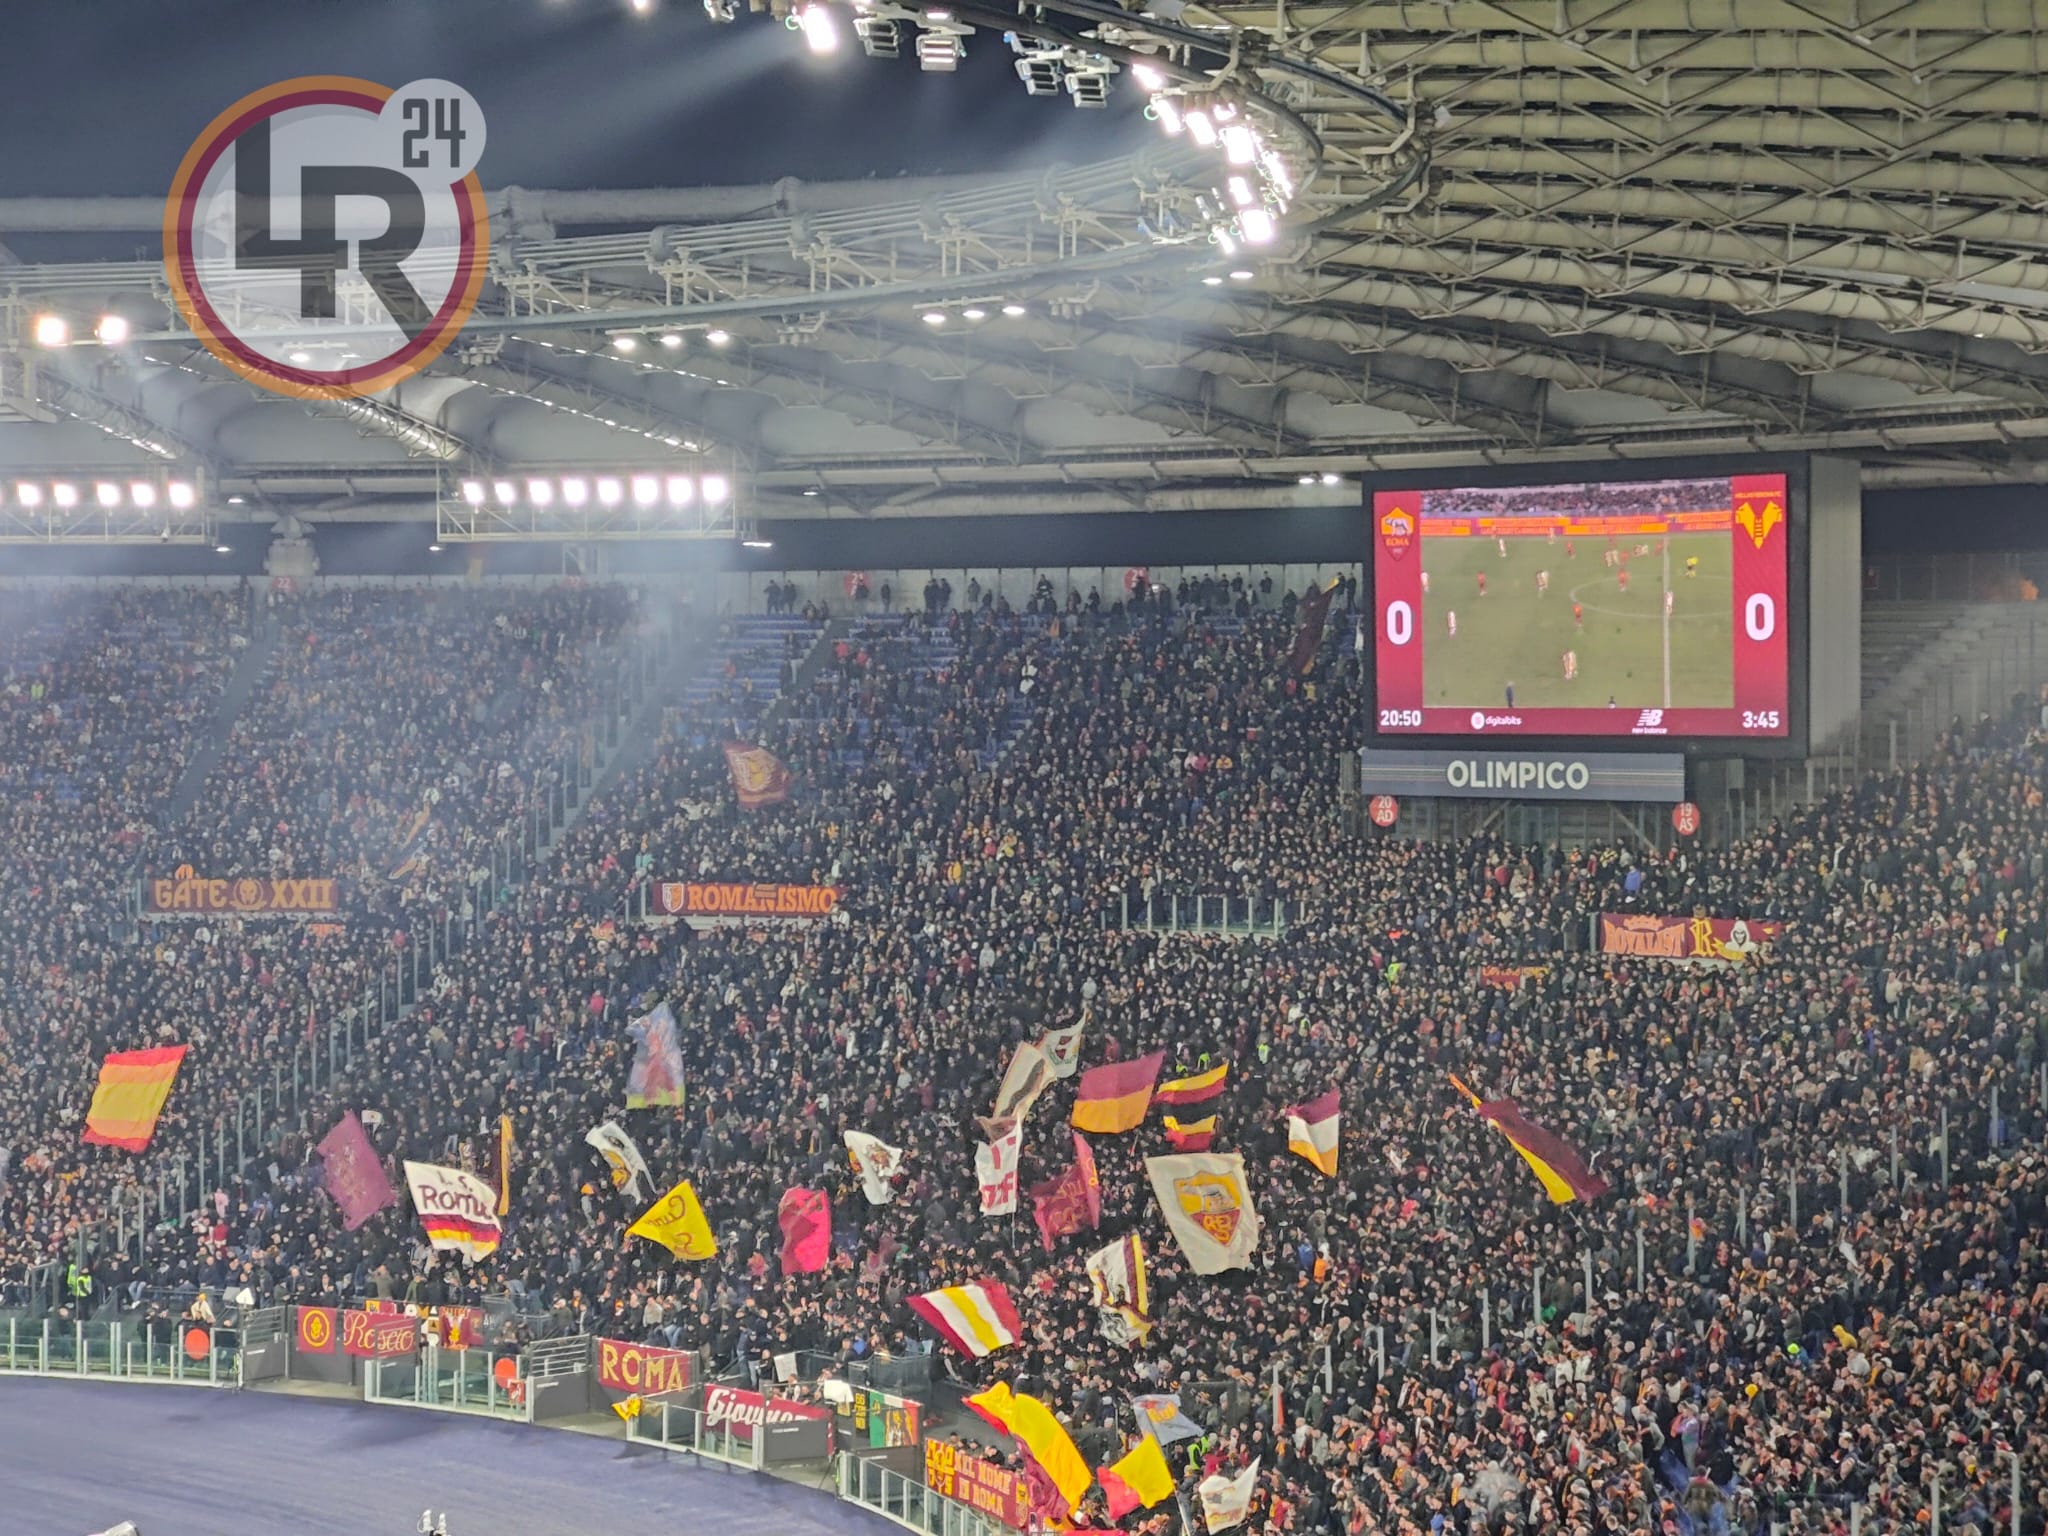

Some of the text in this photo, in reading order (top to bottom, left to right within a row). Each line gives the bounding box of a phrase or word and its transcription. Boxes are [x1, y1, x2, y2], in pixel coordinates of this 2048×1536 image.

[1386, 600, 1412, 646] 0
[1745, 592, 1775, 641] 0
[1380, 709, 1422, 727] 20:50
[1742, 710, 1780, 728] 3:45
[1447, 759, 1590, 790] OLIMPICO
[1378, 795, 1392, 809] 20
[1680, 802, 1692, 817] 19
[1375, 809, 1394, 823] AD
[1679, 816, 1694, 832] AS
[155, 878, 333, 909] GATE XXII
[602, 1342, 684, 1392] ROMA
